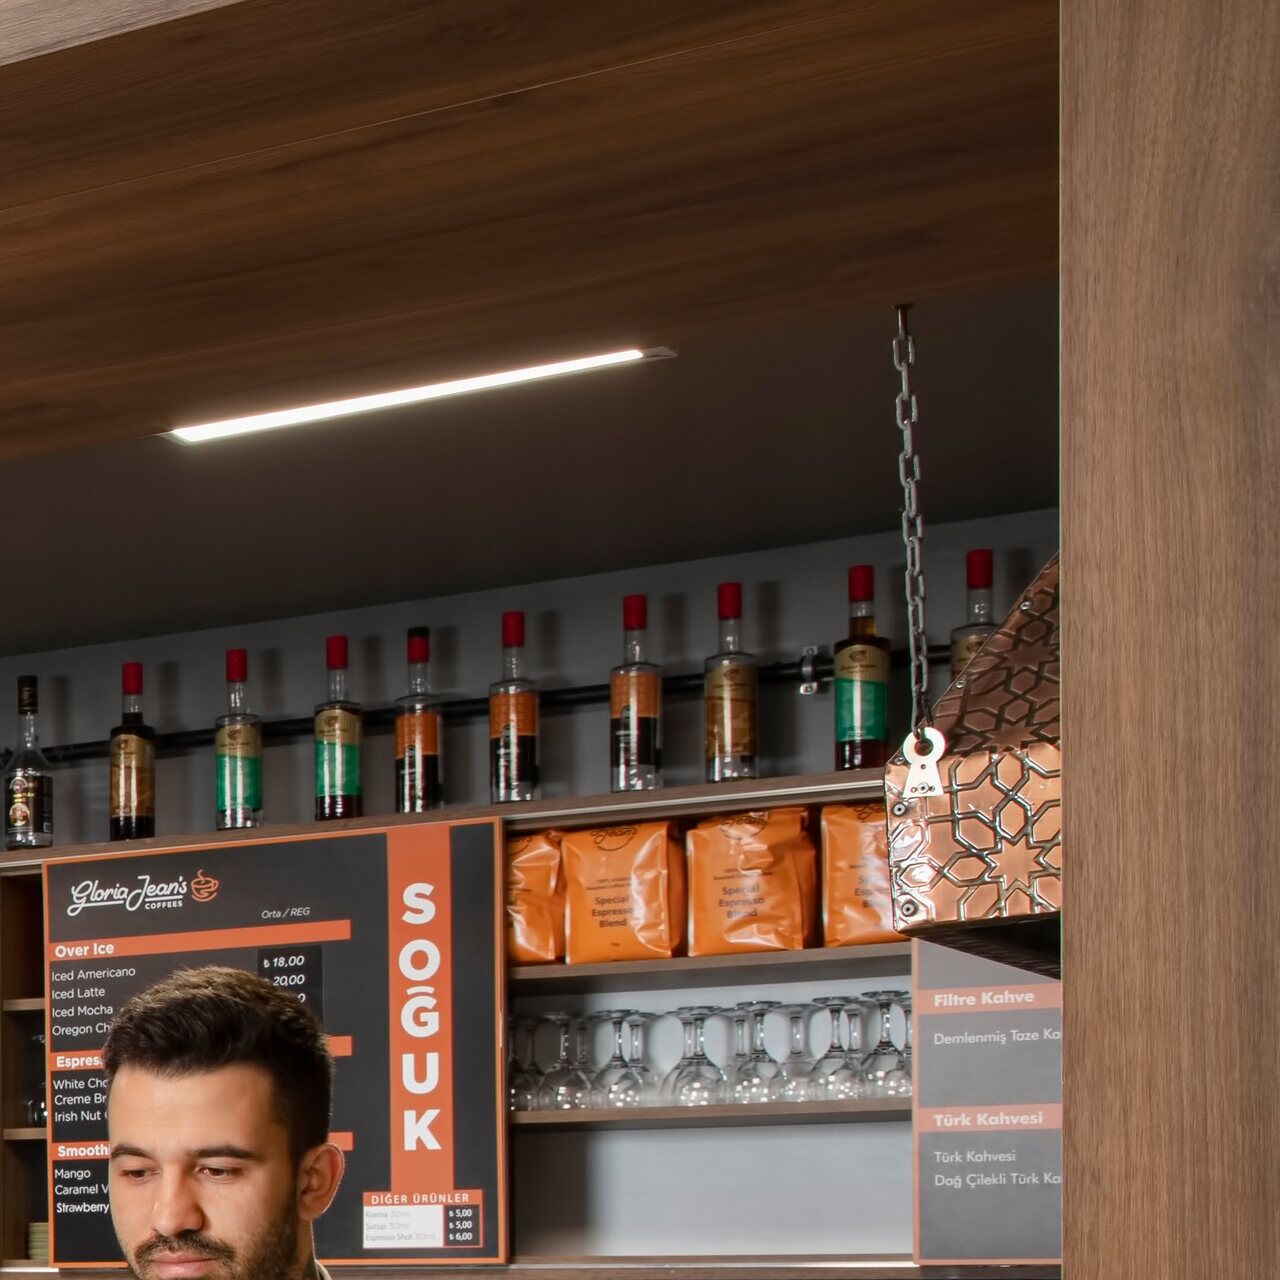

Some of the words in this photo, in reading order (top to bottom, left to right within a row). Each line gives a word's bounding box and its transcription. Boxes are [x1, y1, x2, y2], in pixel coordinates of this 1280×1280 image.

[67, 880, 129, 917] Gloria
[125, 875, 188, 911] Jean's
[144, 900, 183, 910] COFFEES
[261, 910, 281, 919] Orta
[290, 907, 311, 916] REG
[599, 918, 627, 928] Blend
[55, 945, 90, 958] Over
[93, 943, 115, 956] Ice
[52, 970, 74, 982] Iced
[77, 968, 136, 980] Americano
[52, 988, 74, 1000] Iced
[77, 987, 106, 998] Latte
[934, 993, 977, 1007] Filtre
[981, 990, 1035, 1005] Kahve
[52, 1006, 75, 1018] Iced
[77, 1004, 114, 1016] Mocha
[399, 882, 441, 1151] SOĞUK
[52, 1024, 93, 1037] Oregon
[934, 1030, 1006, 1045] Demlenmiş
[1010, 1029, 1040, 1042] Taze
[53, 1079, 85, 1090] White
[54, 1094, 91, 1106] Creme
[54, 1111, 78, 1122] Irish
[81, 1110, 101, 1122] Nut
[934, 1114, 972, 1127] Türk
[976, 1111, 1043, 1126] Kahvesi
[934, 1151, 963, 1163] Türk
[966, 1150, 1016, 1163] Kahvesi
[54, 1168, 91, 1179] Mango
[934, 1174, 962, 1188] Dağ
[966, 1173, 1006, 1188] Çilekli
[1010, 1173, 1040, 1185] Türk
[54, 1184, 98, 1196] Caramel
[371, 1194, 407, 1205] DİĞER
[413, 1192, 469, 1203] ÜRÜNLER
[56, 1202, 110, 1214] Strawberry
